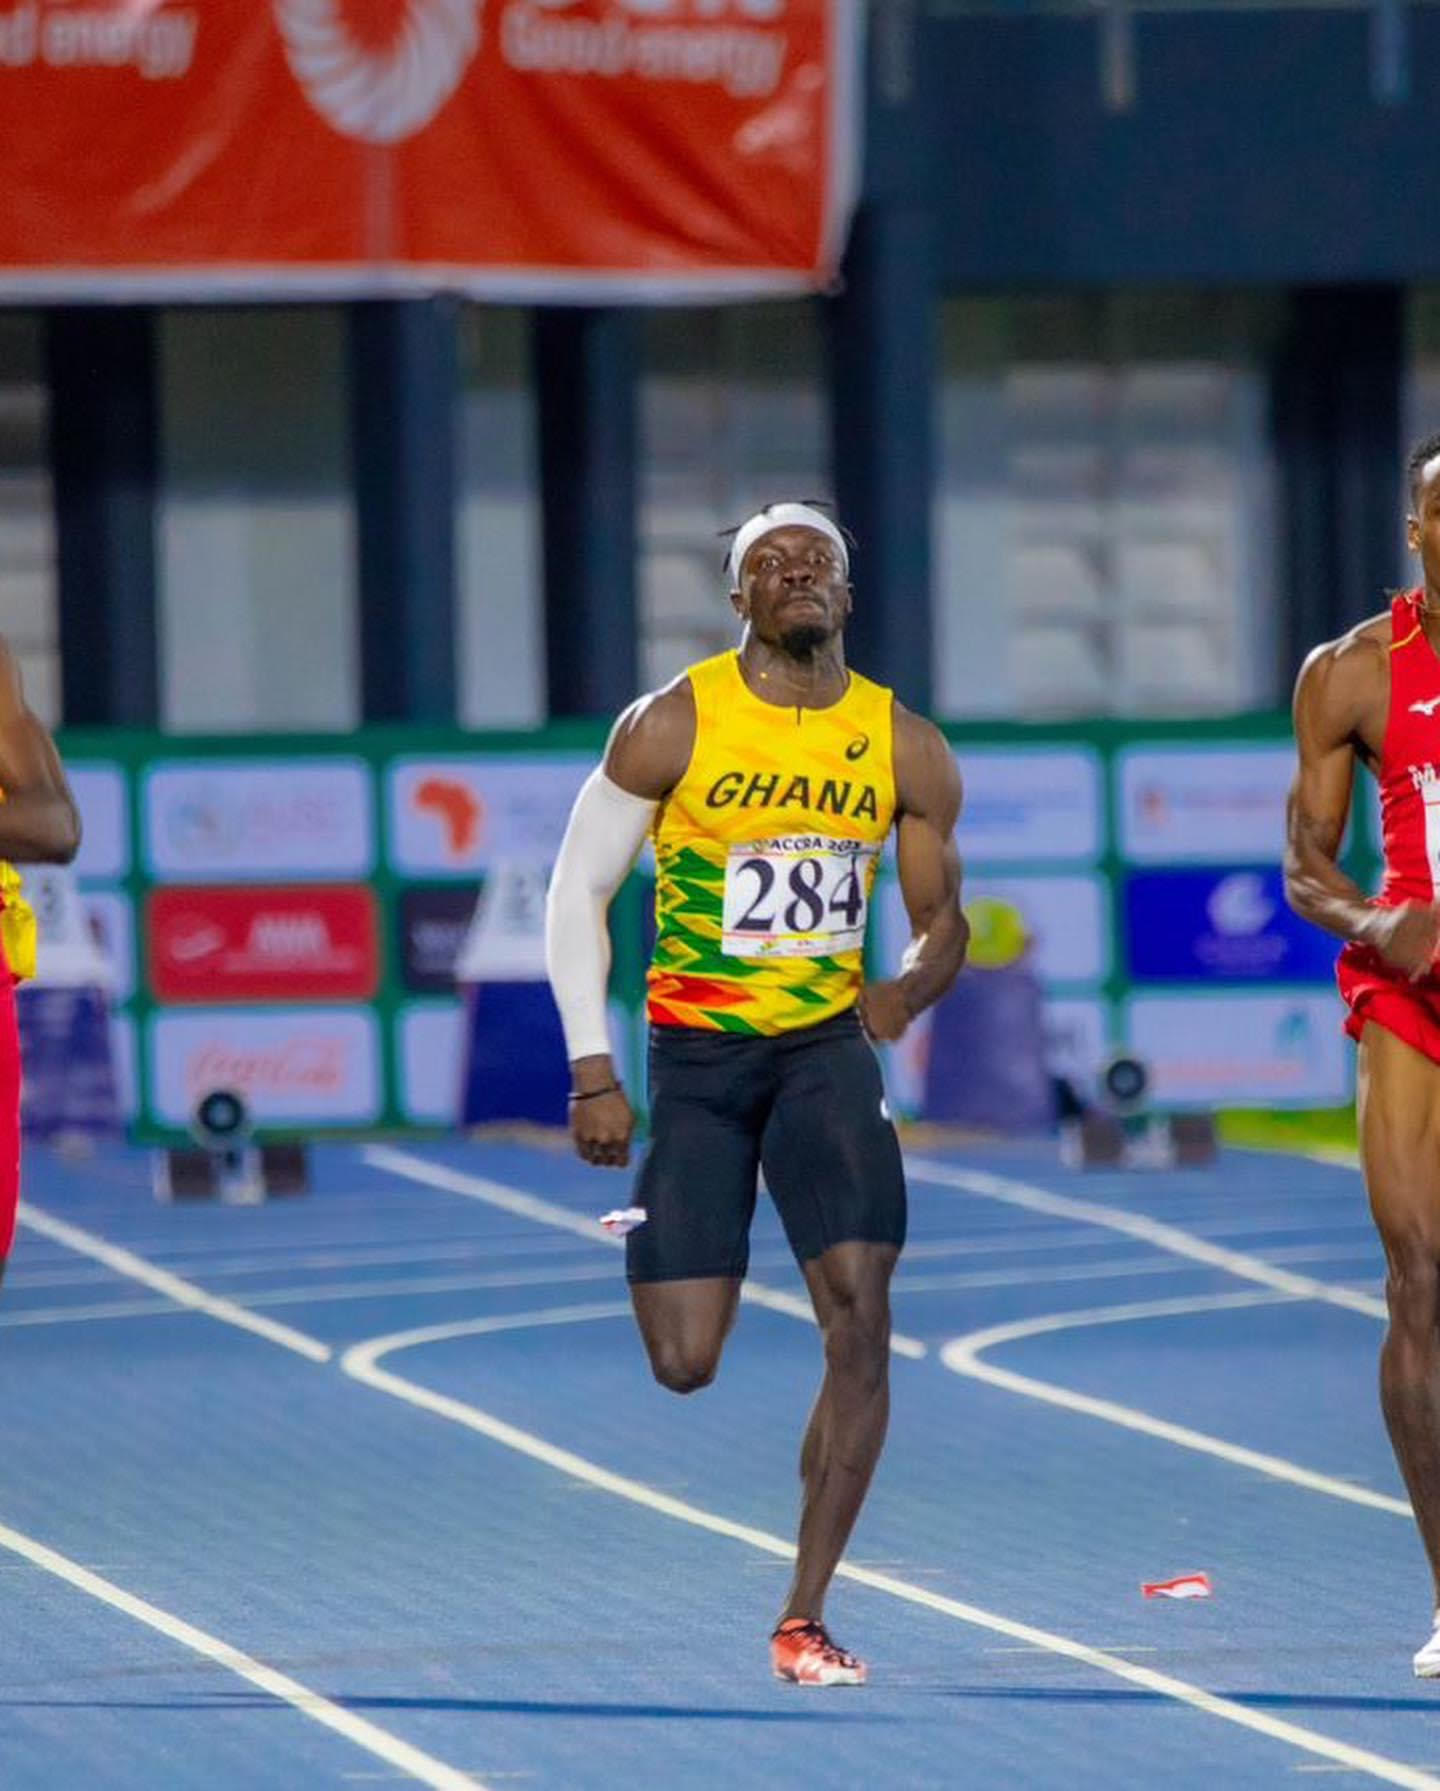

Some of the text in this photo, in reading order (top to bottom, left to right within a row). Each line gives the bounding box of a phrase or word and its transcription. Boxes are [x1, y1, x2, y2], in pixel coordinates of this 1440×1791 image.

[705, 771, 878, 822] GHANA
[771, 838, 822, 850] ACCRA
[735, 855, 862, 933] 284
